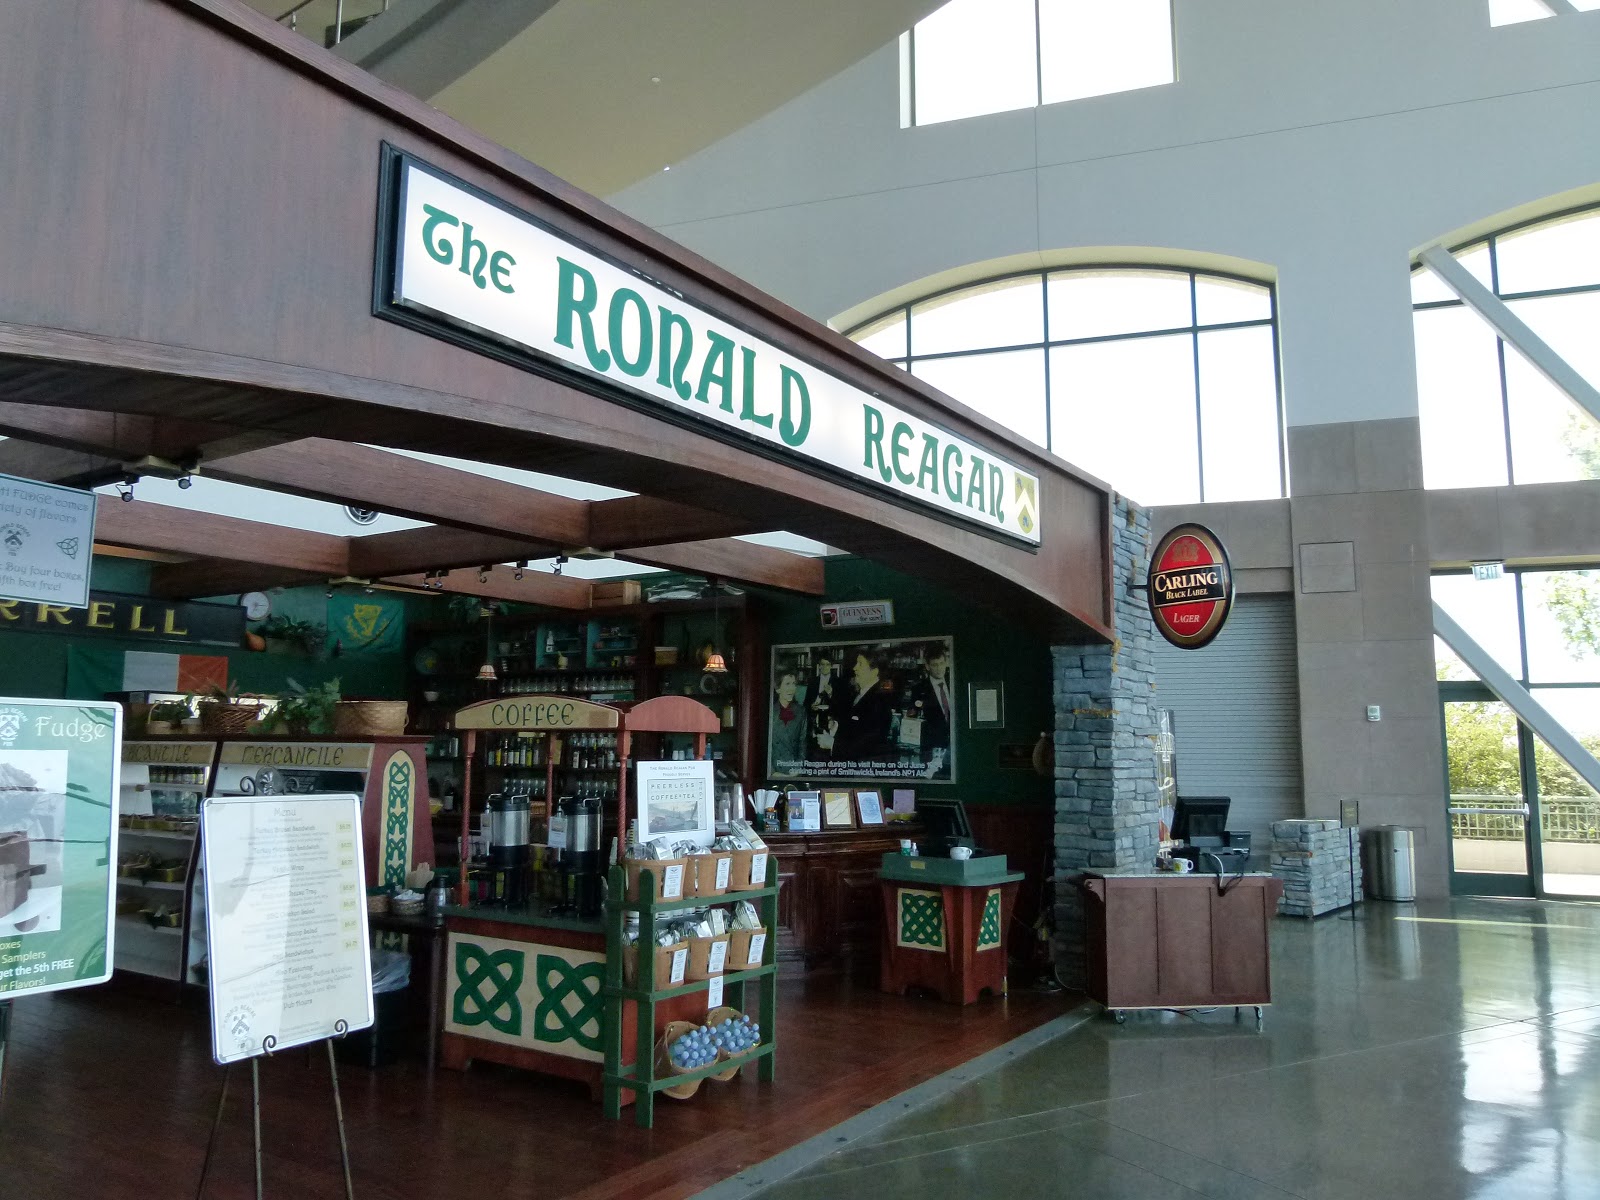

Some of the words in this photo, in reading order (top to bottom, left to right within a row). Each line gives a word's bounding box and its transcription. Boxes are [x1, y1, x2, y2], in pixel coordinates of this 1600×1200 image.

[554, 256, 812, 447] RONALD
[862, 404, 1006, 524] REAGAN
[54, 499, 89, 512] comes
[1479, 565, 1498, 581] EXIT
[1154, 571, 1219, 593] CARLING
[1165, 590, 1187, 600] BLACK
[1187, 588, 1209, 597] LABEL
[1173, 612, 1200, 624] LAGER
[491, 703, 575, 728] COFFEE
[35, 715, 106, 743] Fudge
[804, 760, 826, 768] Reagan
[827, 760, 846, 768] during
[650, 782, 695, 790] PEERLESS
[1, 951, 46, 964] Samplers
[15, 965, 31, 976] the
[33, 962, 50, 973] 5th
[51, 958, 75, 971] FREE
[9, 976, 46, 990] Flavors!
